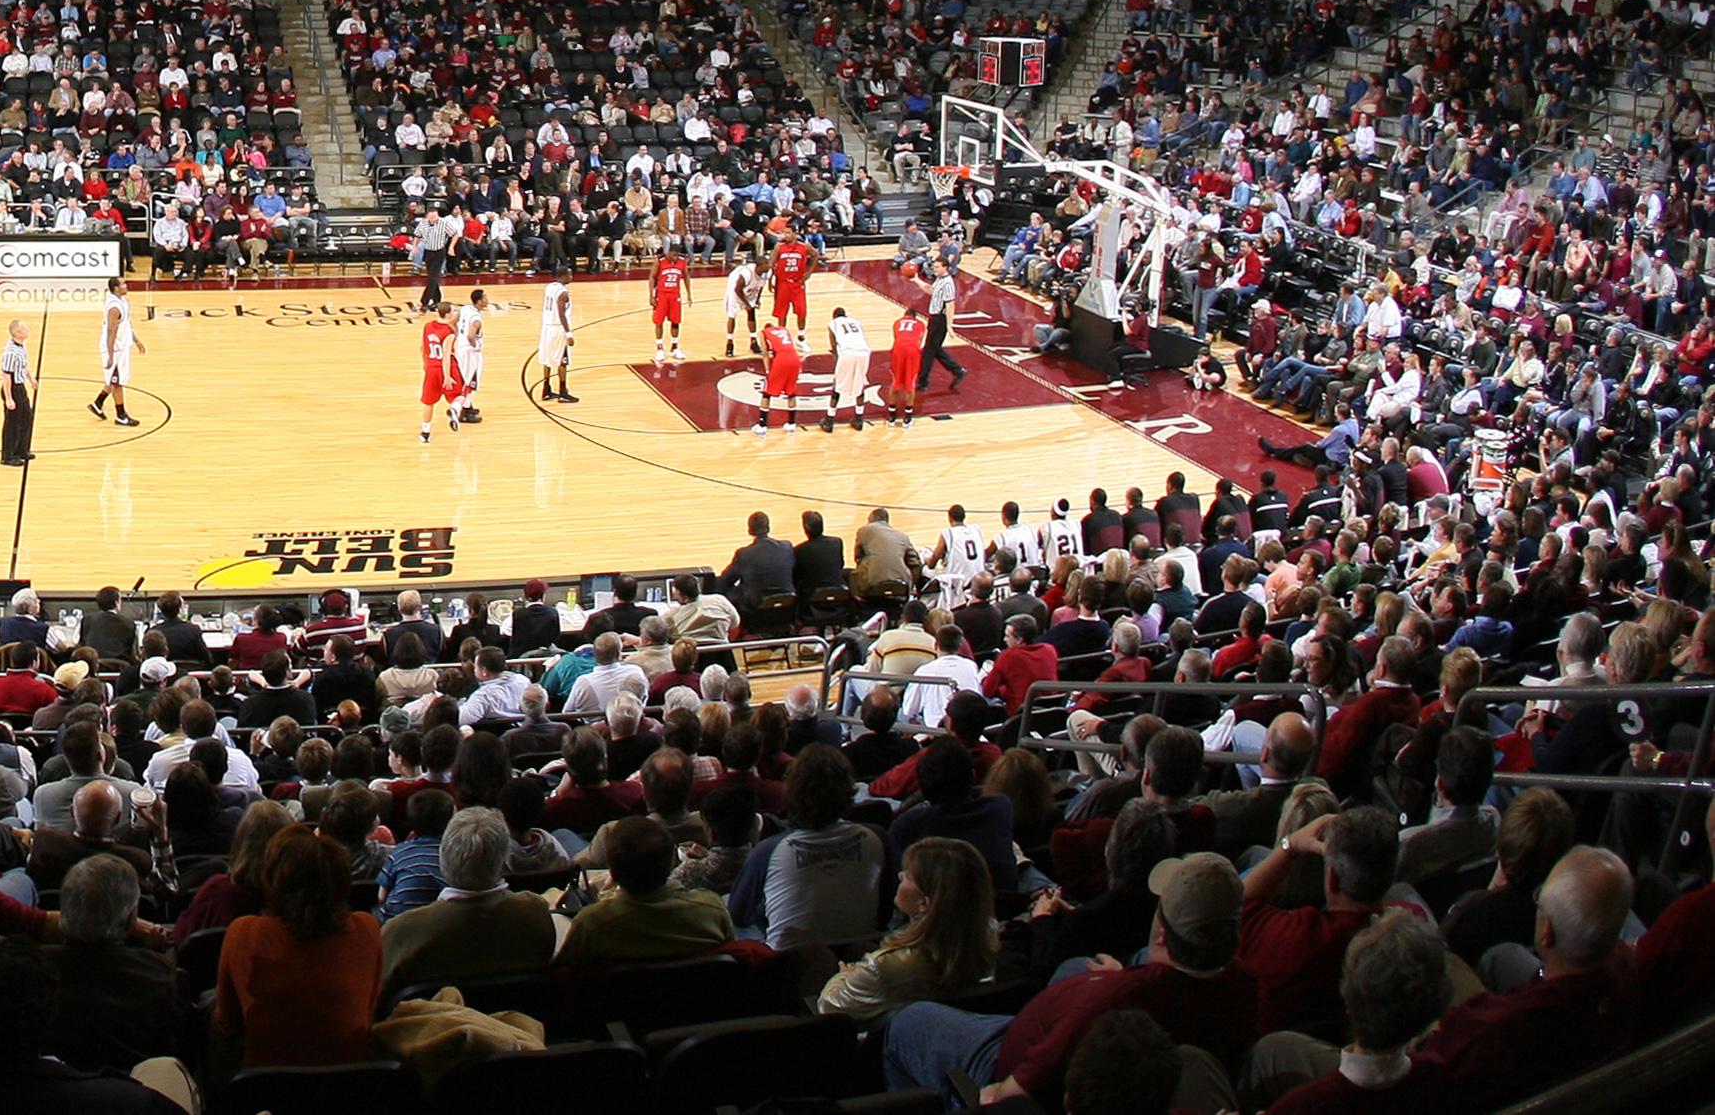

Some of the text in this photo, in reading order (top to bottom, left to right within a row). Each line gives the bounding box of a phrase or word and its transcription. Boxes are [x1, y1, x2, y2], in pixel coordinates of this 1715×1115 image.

[667, 274, 678, 282] 22
[141, 304, 267, 322] Jack
[265, 316, 416, 328] Center
[841, 323, 859, 334] 15
[429, 342, 443, 360] 10
[244, 527, 458, 558] BELT
[252, 529, 395, 539] CONFERENCE
[964, 539, 978, 561] 0
[1018, 542, 1027, 564] 1
[1057, 535, 1079, 555] 21
[272, 552, 454, 579] SUN
[1617, 700, 1644, 735] 3
